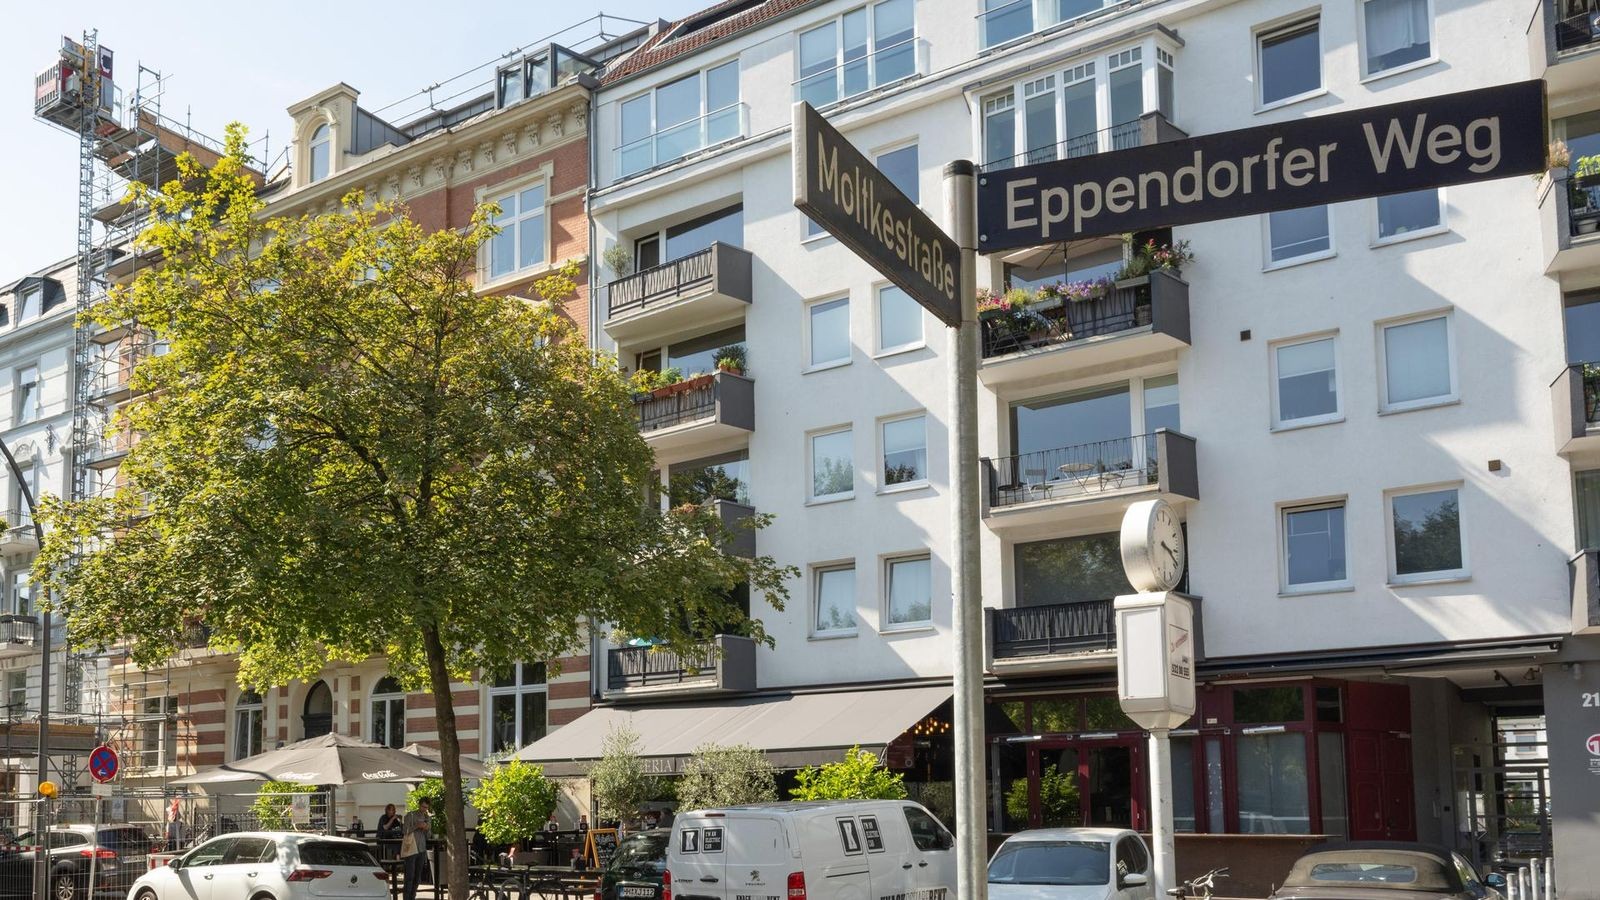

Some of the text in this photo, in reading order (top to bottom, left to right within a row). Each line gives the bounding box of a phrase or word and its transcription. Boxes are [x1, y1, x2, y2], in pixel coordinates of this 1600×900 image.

[818, 131, 954, 299] Moltkestraße
[1006, 113, 1501, 238] Eppendorfer Weg
[644, 758, 673, 773] ERIA
